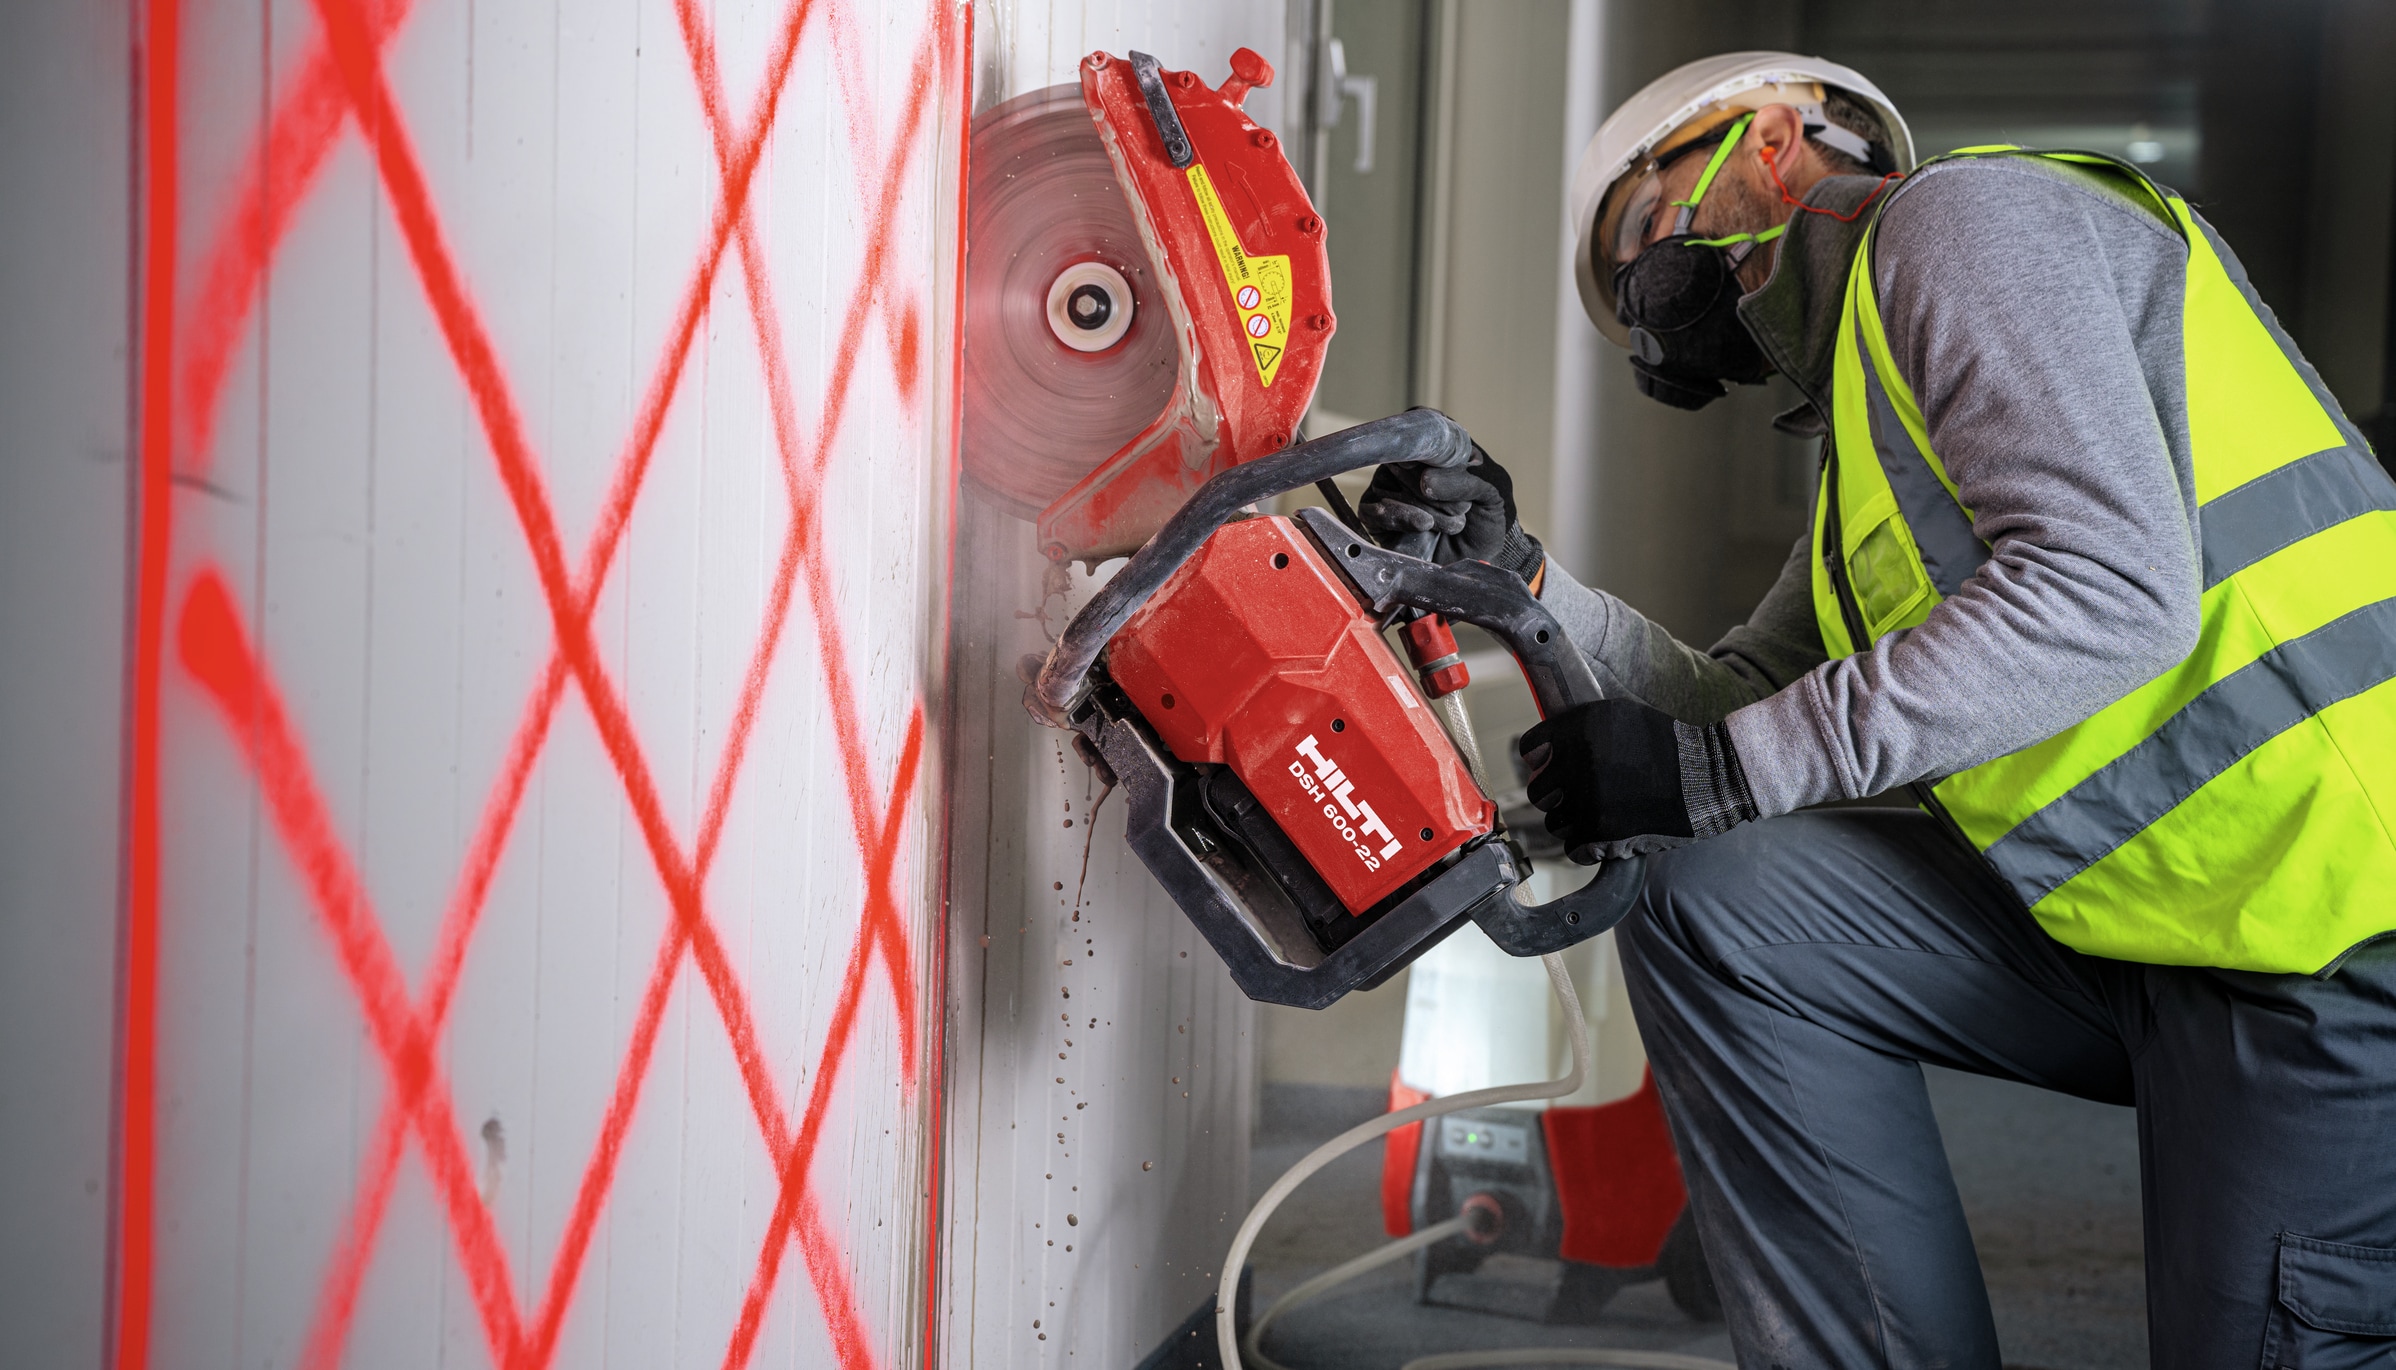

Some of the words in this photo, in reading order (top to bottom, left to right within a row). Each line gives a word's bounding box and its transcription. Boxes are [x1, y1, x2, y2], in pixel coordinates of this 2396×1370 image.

[1231, 244, 1250, 280] WARNING!
[1288, 760, 1326, 803] DSH
[1323, 803, 1381, 873] 600-22
[1295, 734, 1403, 861] HILTI
